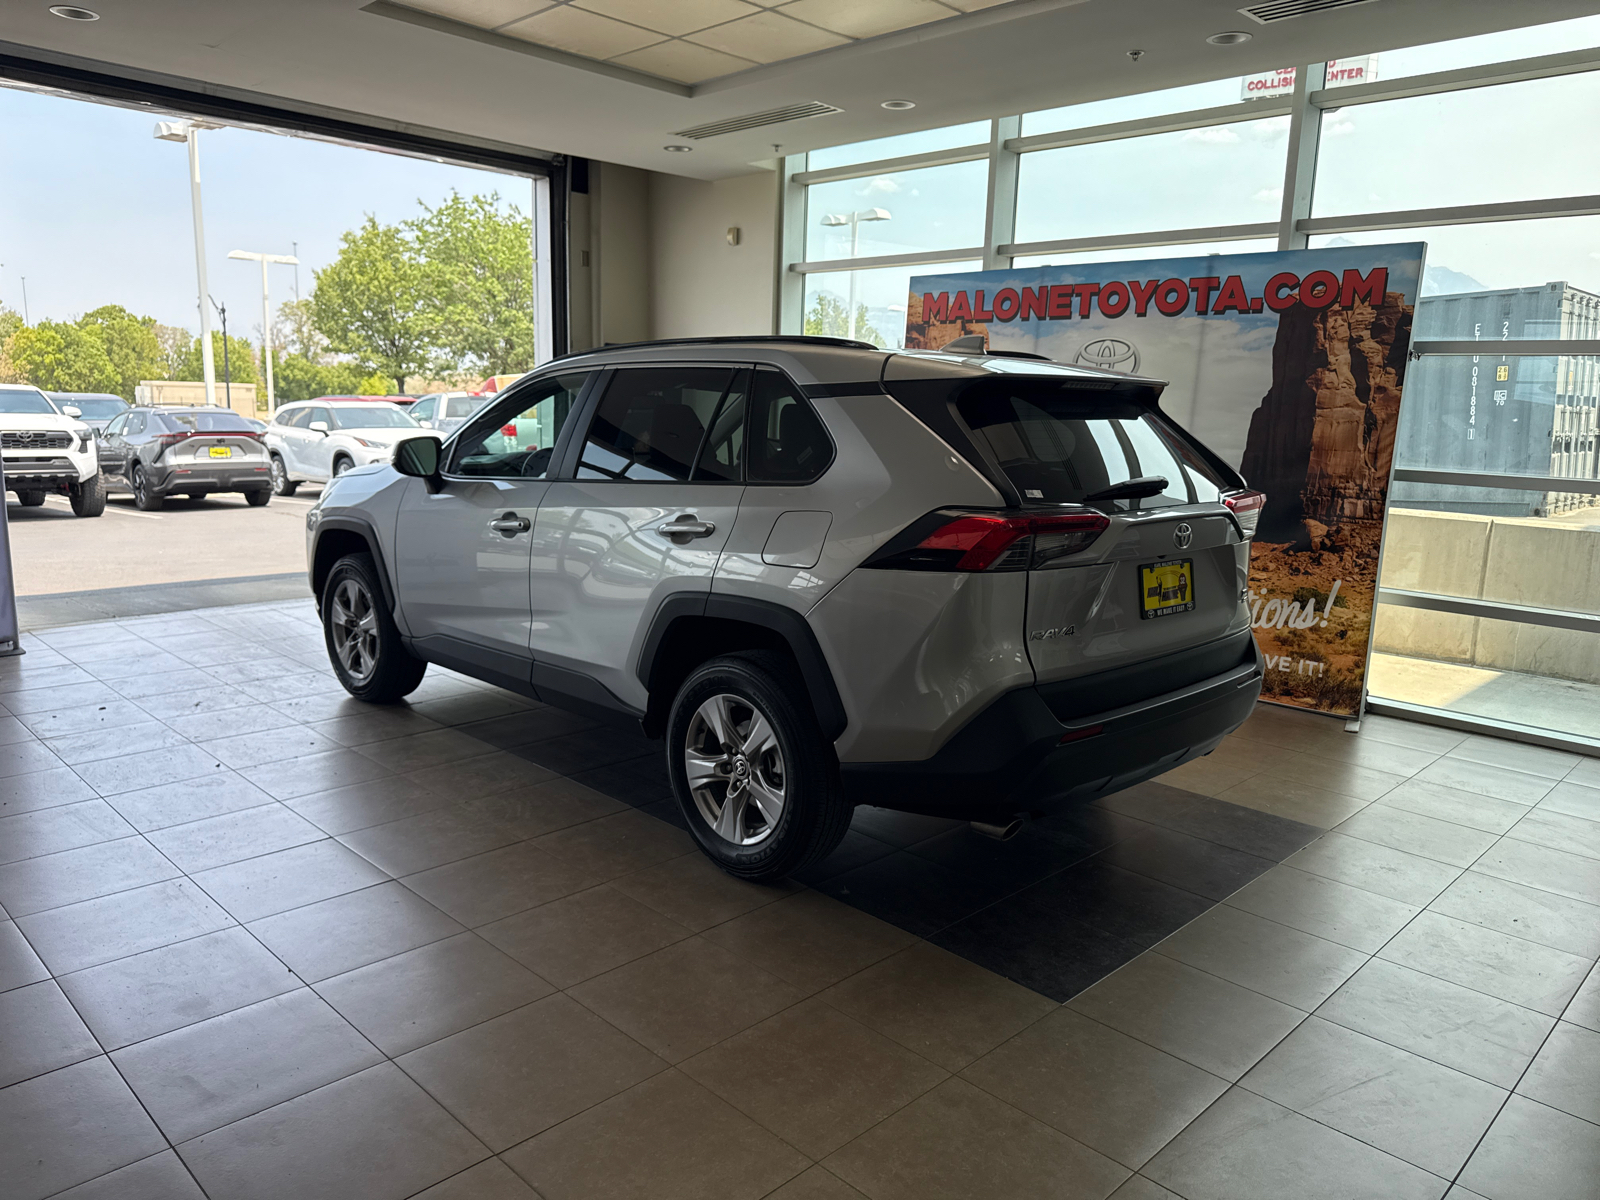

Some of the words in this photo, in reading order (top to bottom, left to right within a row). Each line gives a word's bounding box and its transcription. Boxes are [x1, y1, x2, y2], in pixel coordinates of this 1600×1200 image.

[1247, 76, 1295, 91] COLLISI
[922, 266, 1389, 325] MALONETOYOTA.COM
[1029, 624, 1075, 641] RAV4
[1263, 653, 1292, 673] VE
[1298, 659, 1324, 678] IT!
